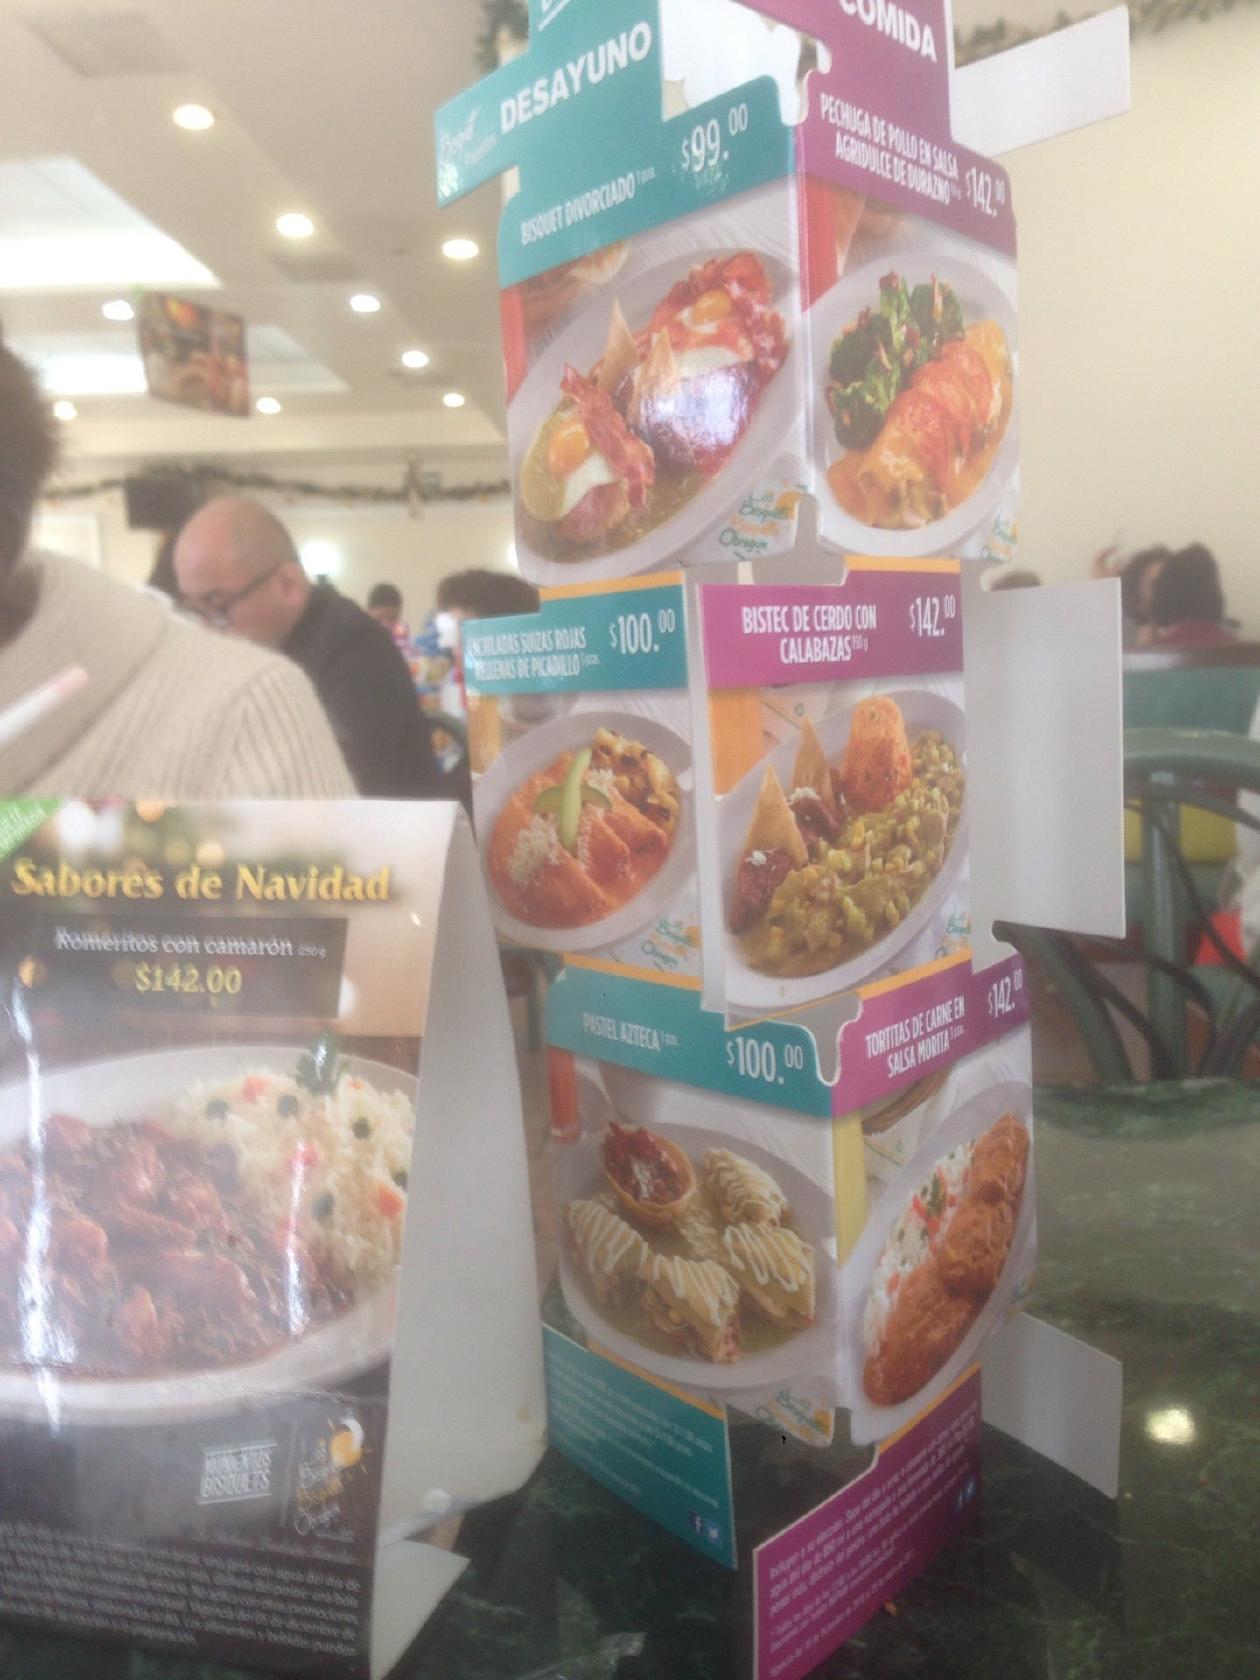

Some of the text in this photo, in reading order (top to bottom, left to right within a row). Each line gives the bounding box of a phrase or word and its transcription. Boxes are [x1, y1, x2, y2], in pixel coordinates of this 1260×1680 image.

[500, 20, 652, 134] DESAYUNO
[821, 92, 960, 181] PECHUGA DE POLLO EN SALSA
[835, 131, 892, 180] AGRIDULCE
[893, 157, 907, 187] DE
[908, 165, 950, 206] DURAZNO
[520, 204, 565, 246] BISQUET
[565, 173, 636, 227] DIVORCIADO
[521, 629, 553, 652] SUIZAS
[555, 626, 586, 650] ROJAS
[742, 605, 877, 634] BISTEC DE CERDO CON
[517, 657, 530, 679] DE
[531, 653, 580, 678] PICADILLO
[780, 636, 852, 664] CALABAZAS
[12, 857, 391, 902] Sabores de Navidad
[54, 925, 159, 954] Romeritos
[160, 934, 200, 955] con
[203, 933, 294, 957] camarón
[134, 961, 243, 994] $142.00
[582, 1012, 618, 1041] PASTEL
[620, 1022, 661, 1052] AZTECA
[866, 994, 966, 1059] TORTITAS DE CARNE EN
[888, 1045, 916, 1078] SALSA
[918, 1029, 950, 1065] MORITA
